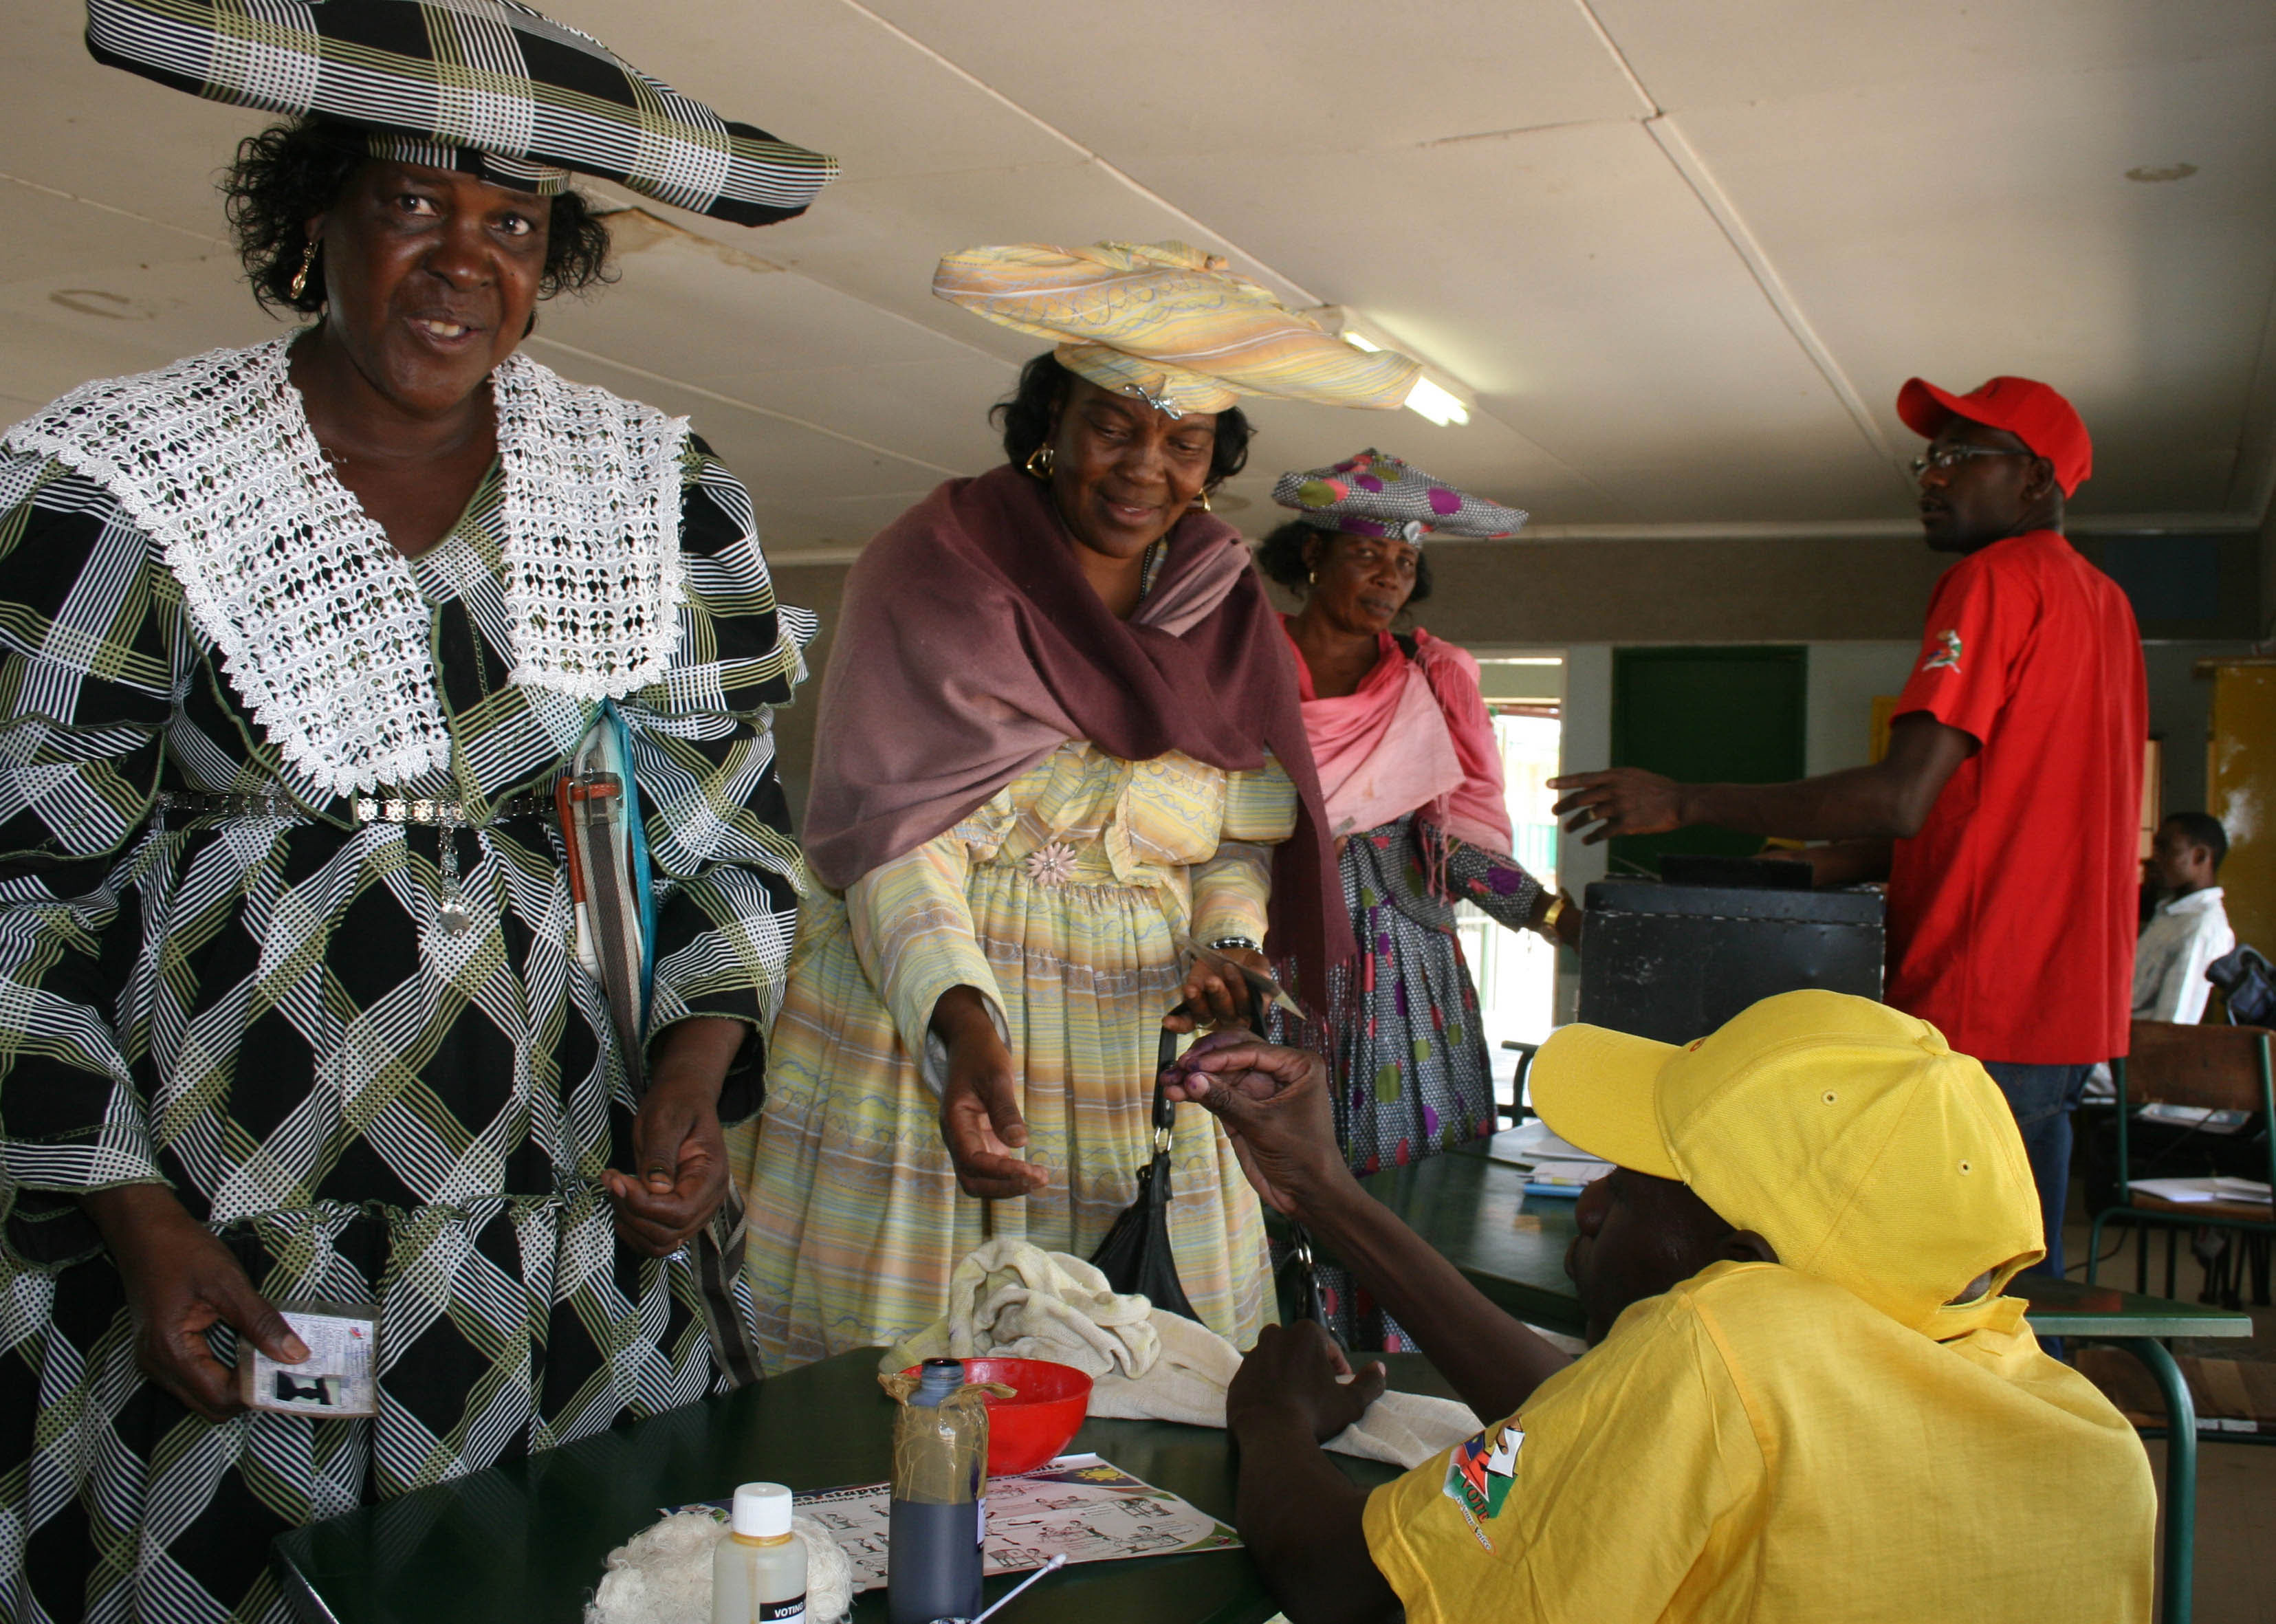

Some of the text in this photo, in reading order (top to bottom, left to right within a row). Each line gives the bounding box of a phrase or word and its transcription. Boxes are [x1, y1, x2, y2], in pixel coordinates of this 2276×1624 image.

[1462, 1476, 1490, 1524] VOTE
[1474, 1524, 1492, 1550] Voice
[774, 1601, 804, 1618] VOTING
